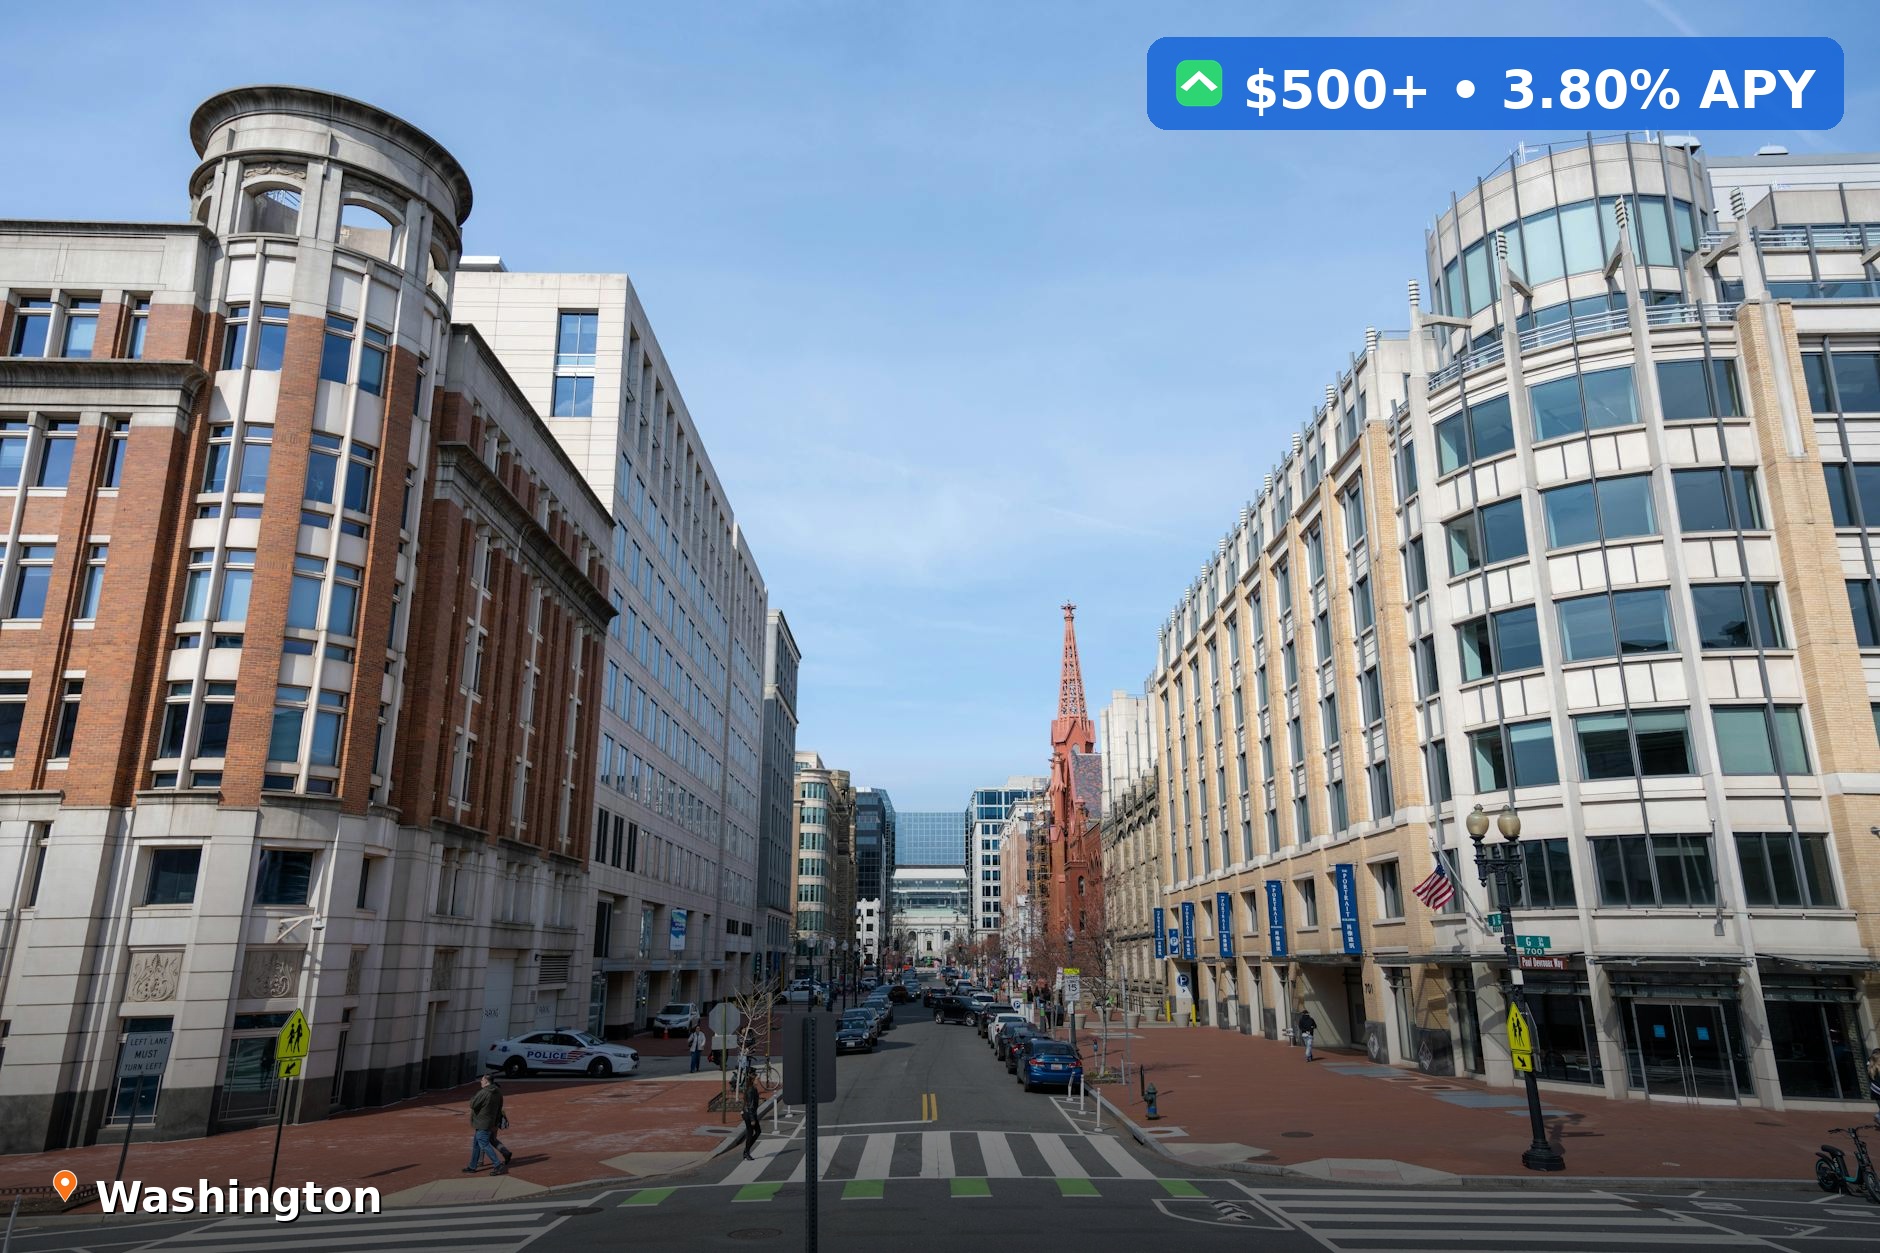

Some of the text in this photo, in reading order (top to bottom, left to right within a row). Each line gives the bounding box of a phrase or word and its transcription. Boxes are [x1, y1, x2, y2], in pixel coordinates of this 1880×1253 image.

[1342, 873, 1351, 917] PORTRAIT
[1525, 937, 1531, 946] G
[1521, 957, 1533, 967] Paul
[1553, 958, 1564, 970] Way
[1068, 983, 1077, 992] 15
[130, 1037, 169, 1046] LEFT LANE
[134, 1050, 158, 1059] MUST
[527, 1051, 568, 1060] POLICE
[125, 1062, 163, 1071] TURN LEFT
